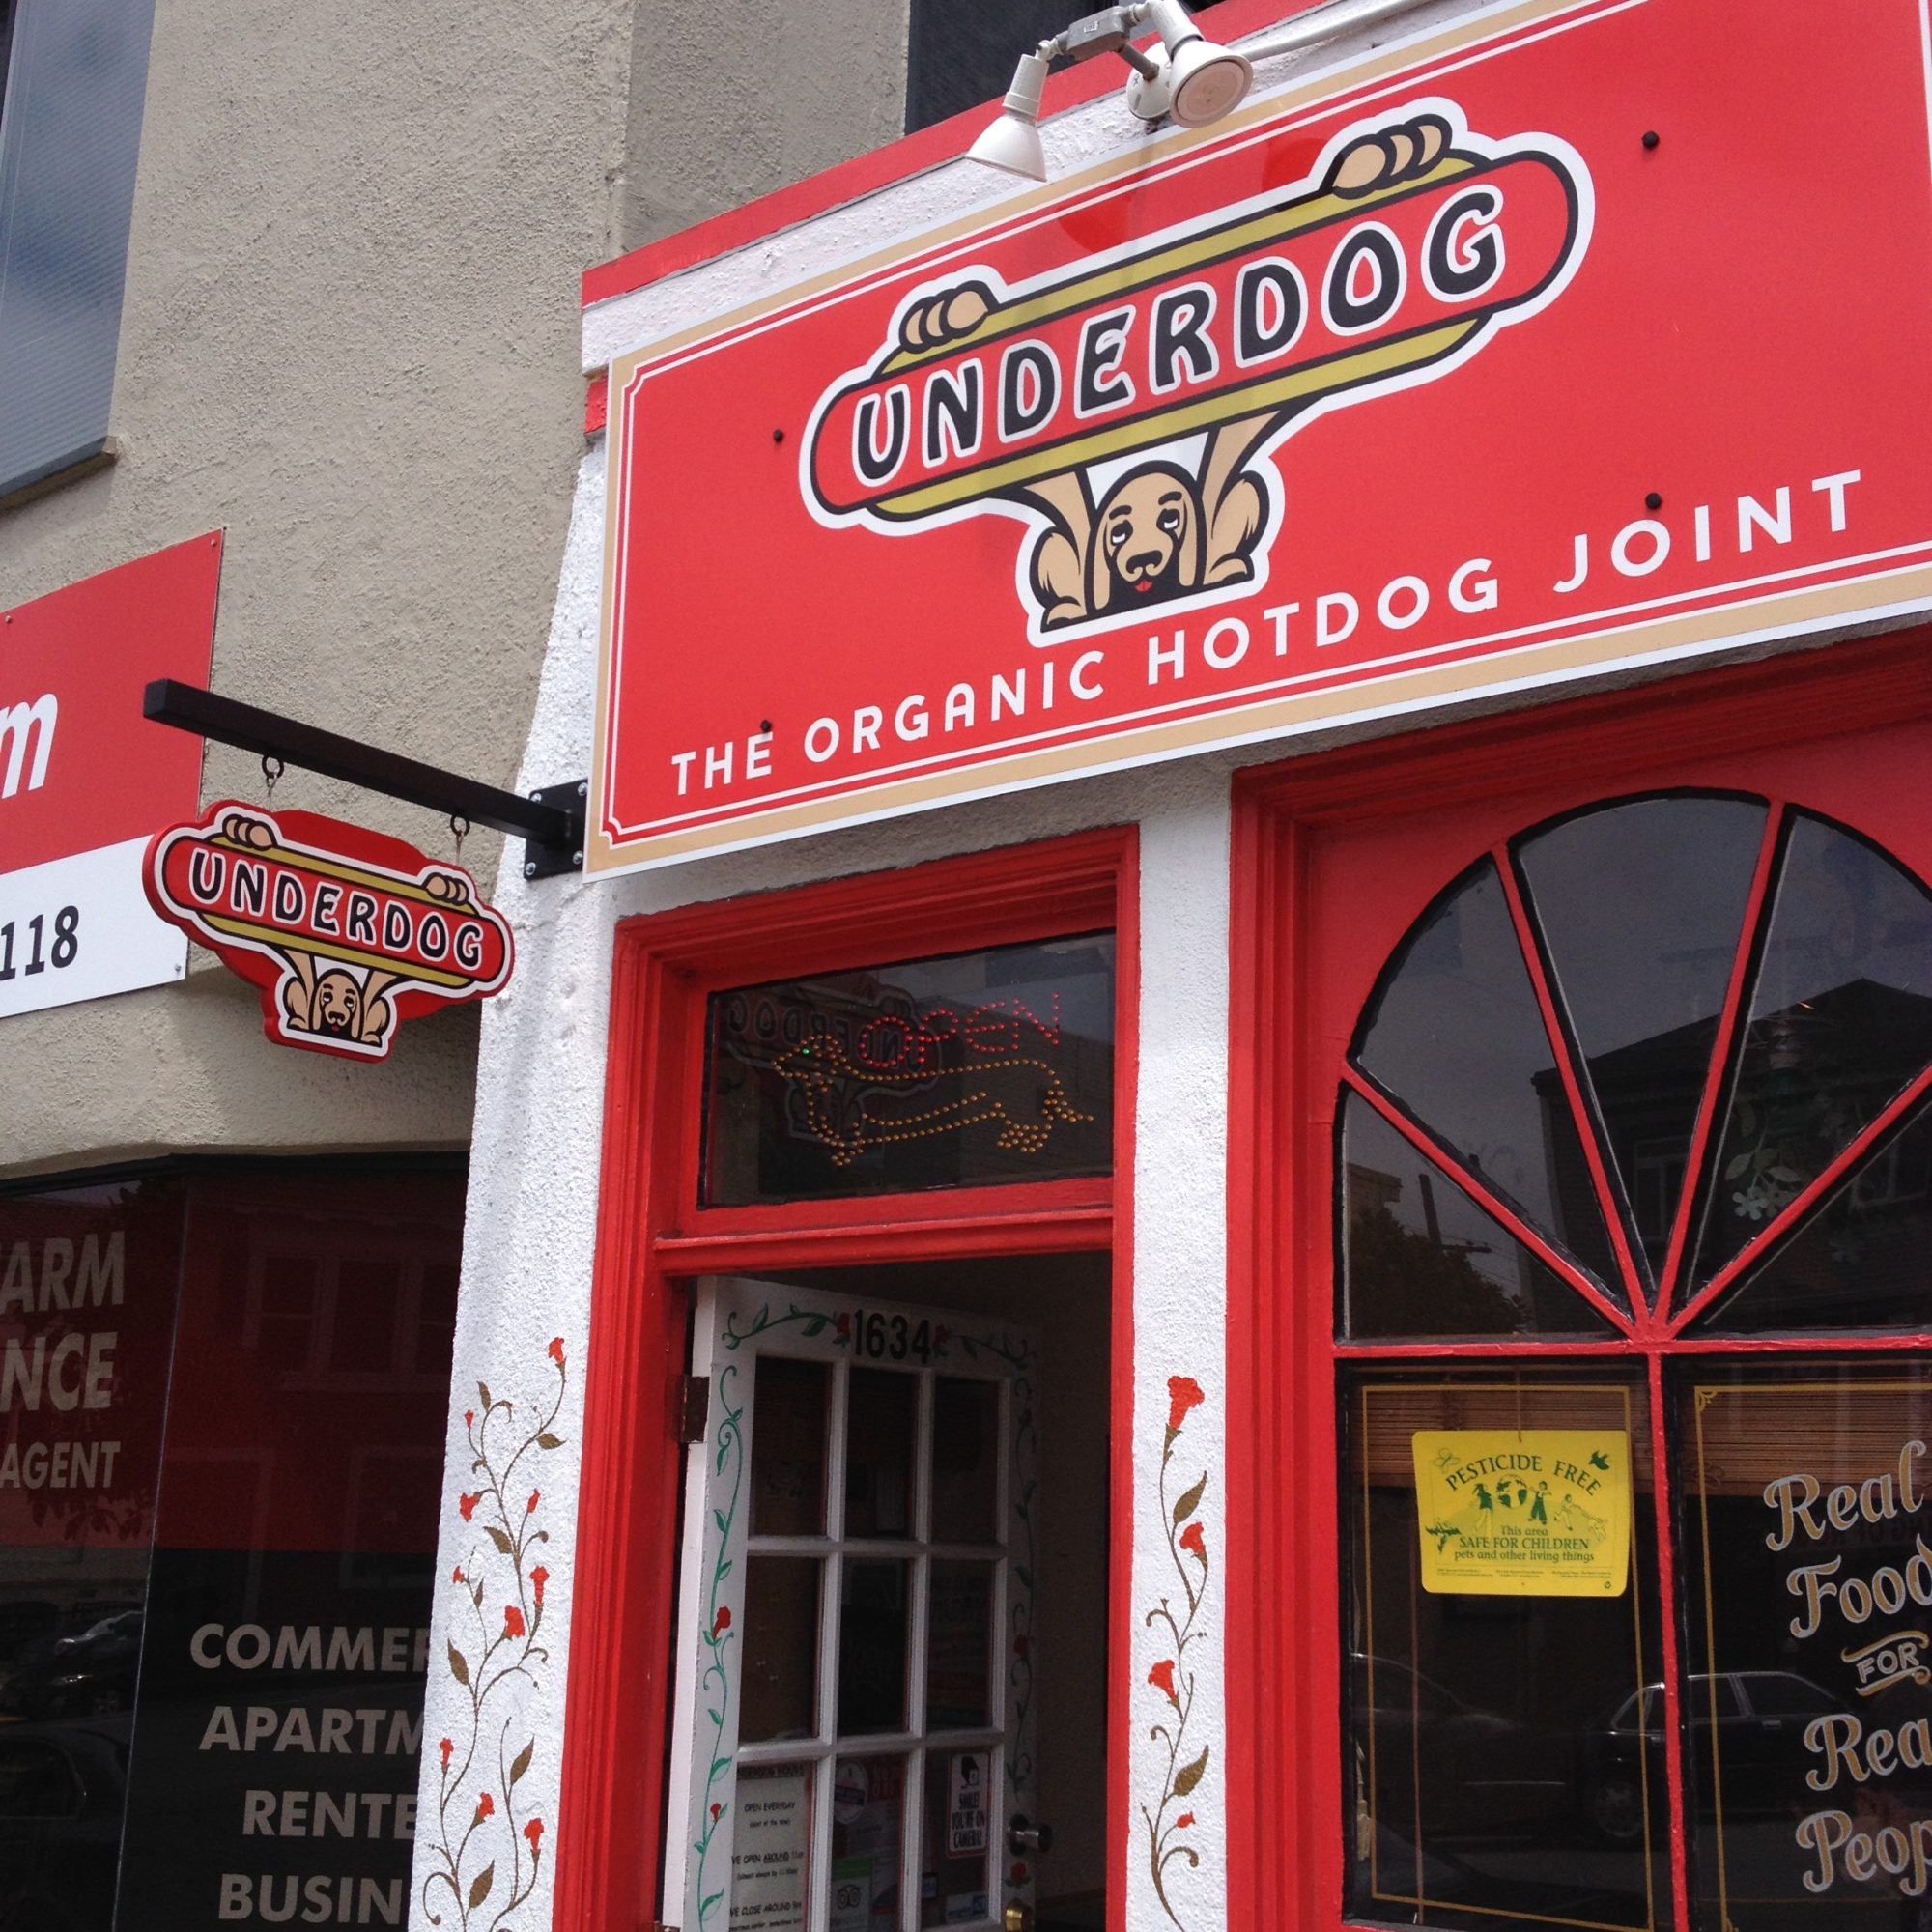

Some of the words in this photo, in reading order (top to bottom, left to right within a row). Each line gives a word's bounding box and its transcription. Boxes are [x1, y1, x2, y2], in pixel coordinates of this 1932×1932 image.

[855, 186, 1503, 485] UNDERDOG
[671, 731, 773, 796] THE
[804, 650, 1105, 762] ORGANIC
[1147, 558, 1499, 685] HOTDOG
[1552, 469, 1861, 593] JOINT
[189, 847, 486, 971] UNDERDOG
[859, 992, 1060, 1067] OPEN
[855, 1309, 931, 1364] 1634
[0, 1441, 121, 1489] AGENT
[1444, 1453, 1544, 1492] PESTICIDE
[1553, 1460, 1602, 1496] FREE
[1763, 1440, 1926, 1551] Real
[1454, 1549, 1474, 1562] pets
[1476, 1549, 1497, 1560] and
[1499, 1549, 1527, 1561] other
[1529, 1549, 1559, 1564] living
[1562, 1550, 1595, 1564] things
[1459, 1535, 1490, 1549] SAFE
[1493, 1536, 1519, 1549] FOR
[1521, 1536, 1590, 1550] CHILDREN
[1501, 1525, 1522, 1537] This
[1524, 1527, 1548, 1537] area
[1855, 1641, 1920, 1684] FOR
[242, 1789, 418, 1840] RENTE
[218, 1873, 403, 1925] BUSIN
